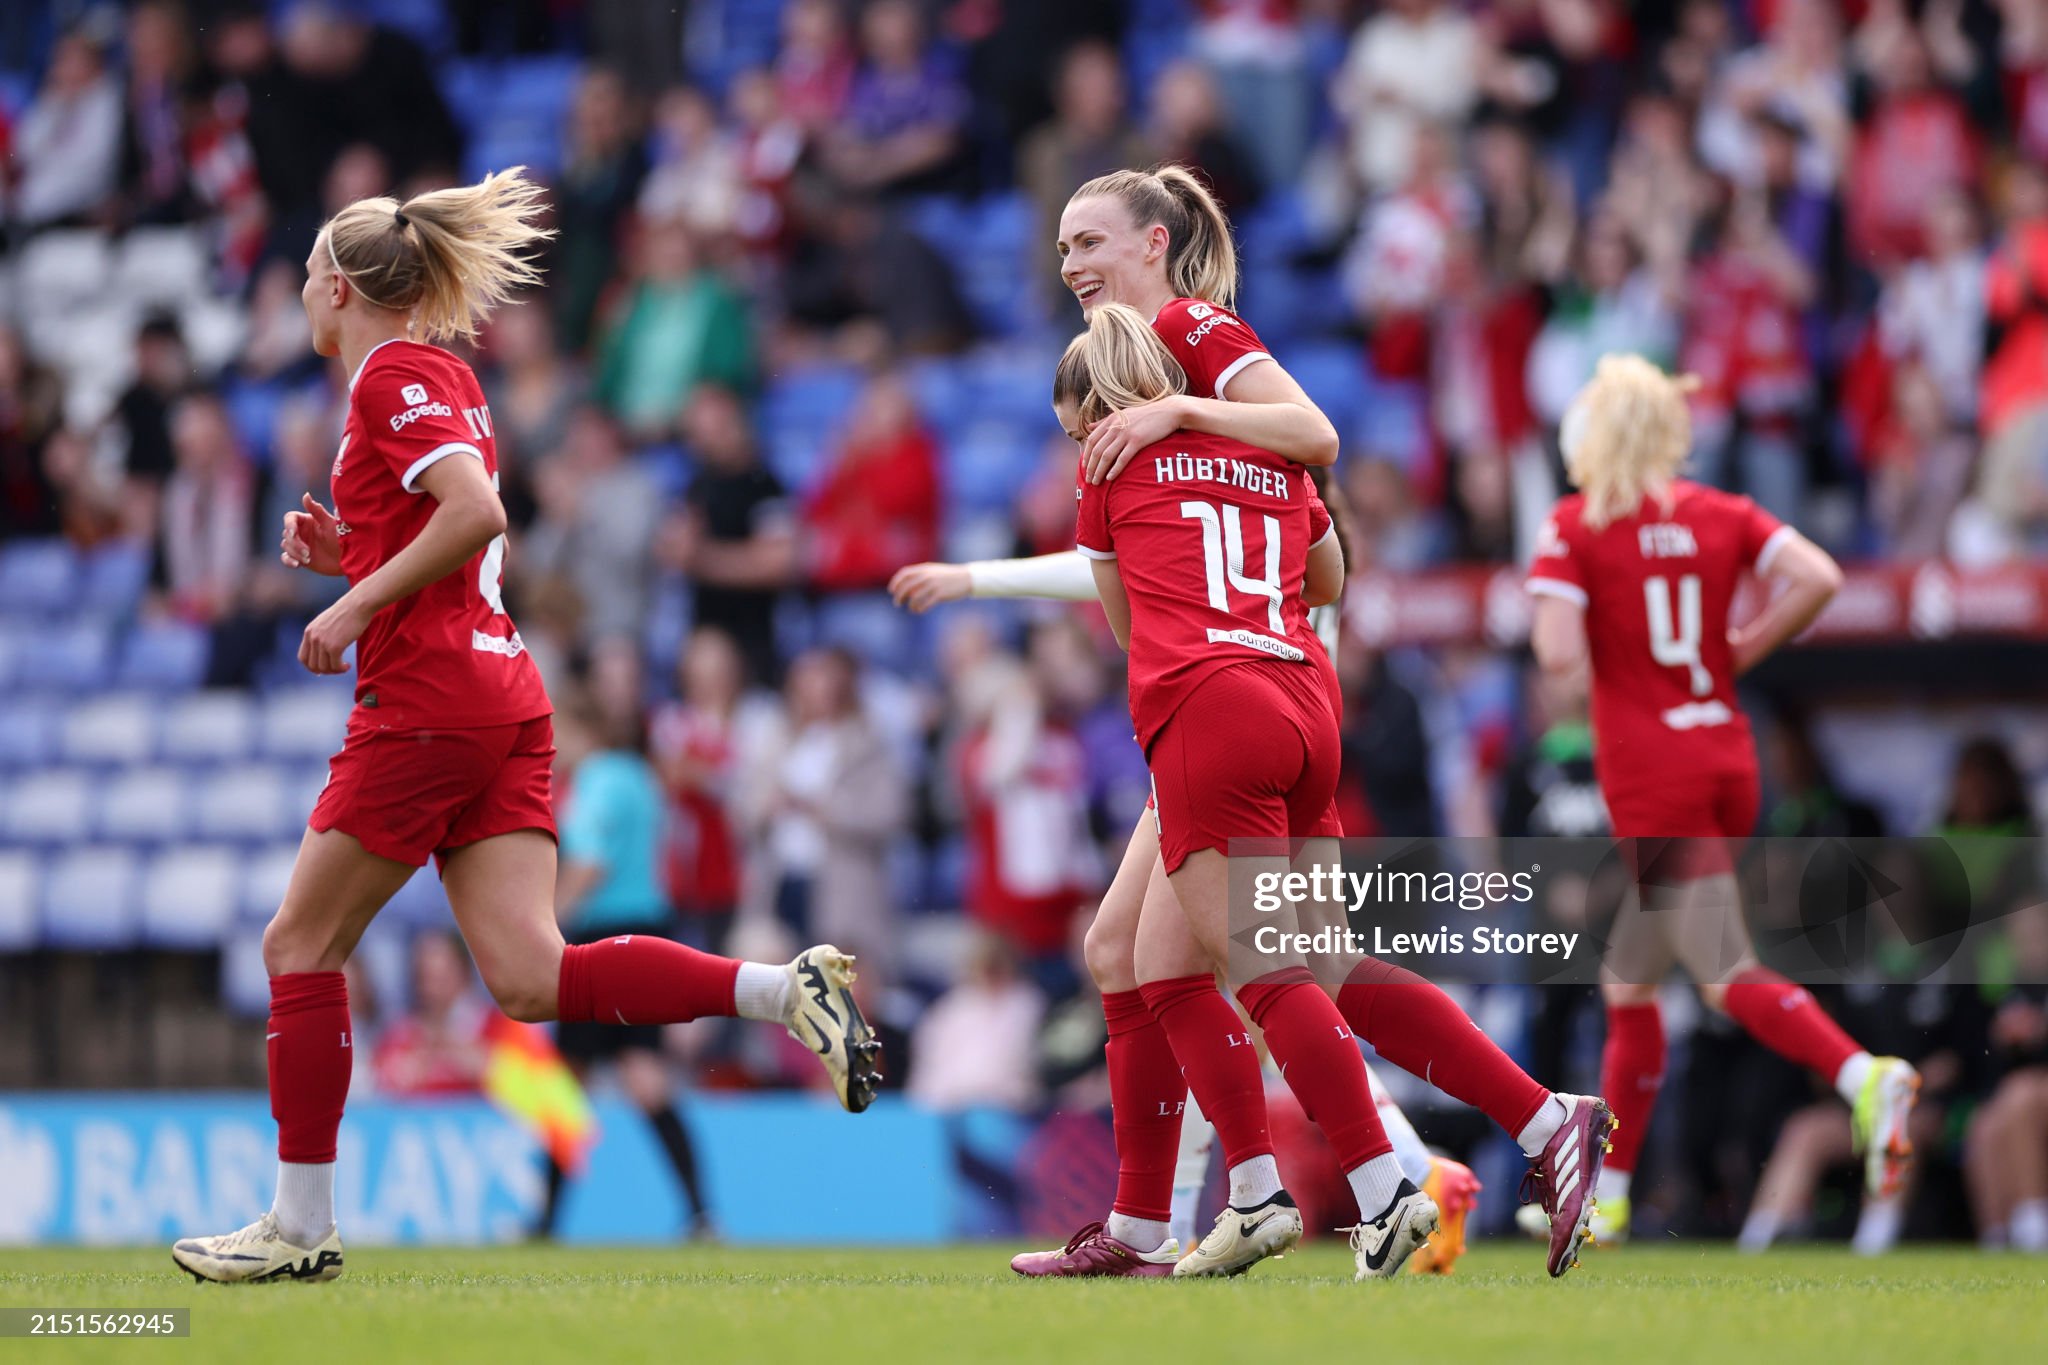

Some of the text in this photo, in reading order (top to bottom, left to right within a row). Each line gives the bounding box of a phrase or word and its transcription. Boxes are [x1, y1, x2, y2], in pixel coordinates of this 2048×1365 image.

[389, 402, 452, 432] Expedia
[1155, 453, 1289, 500] HÖBINGER
[1180, 501, 1287, 636] 14
[1228, 631, 1302, 660] Foundation
[1644, 575, 1714, 697] 4
[74, 1117, 547, 1240] BARLAYS
